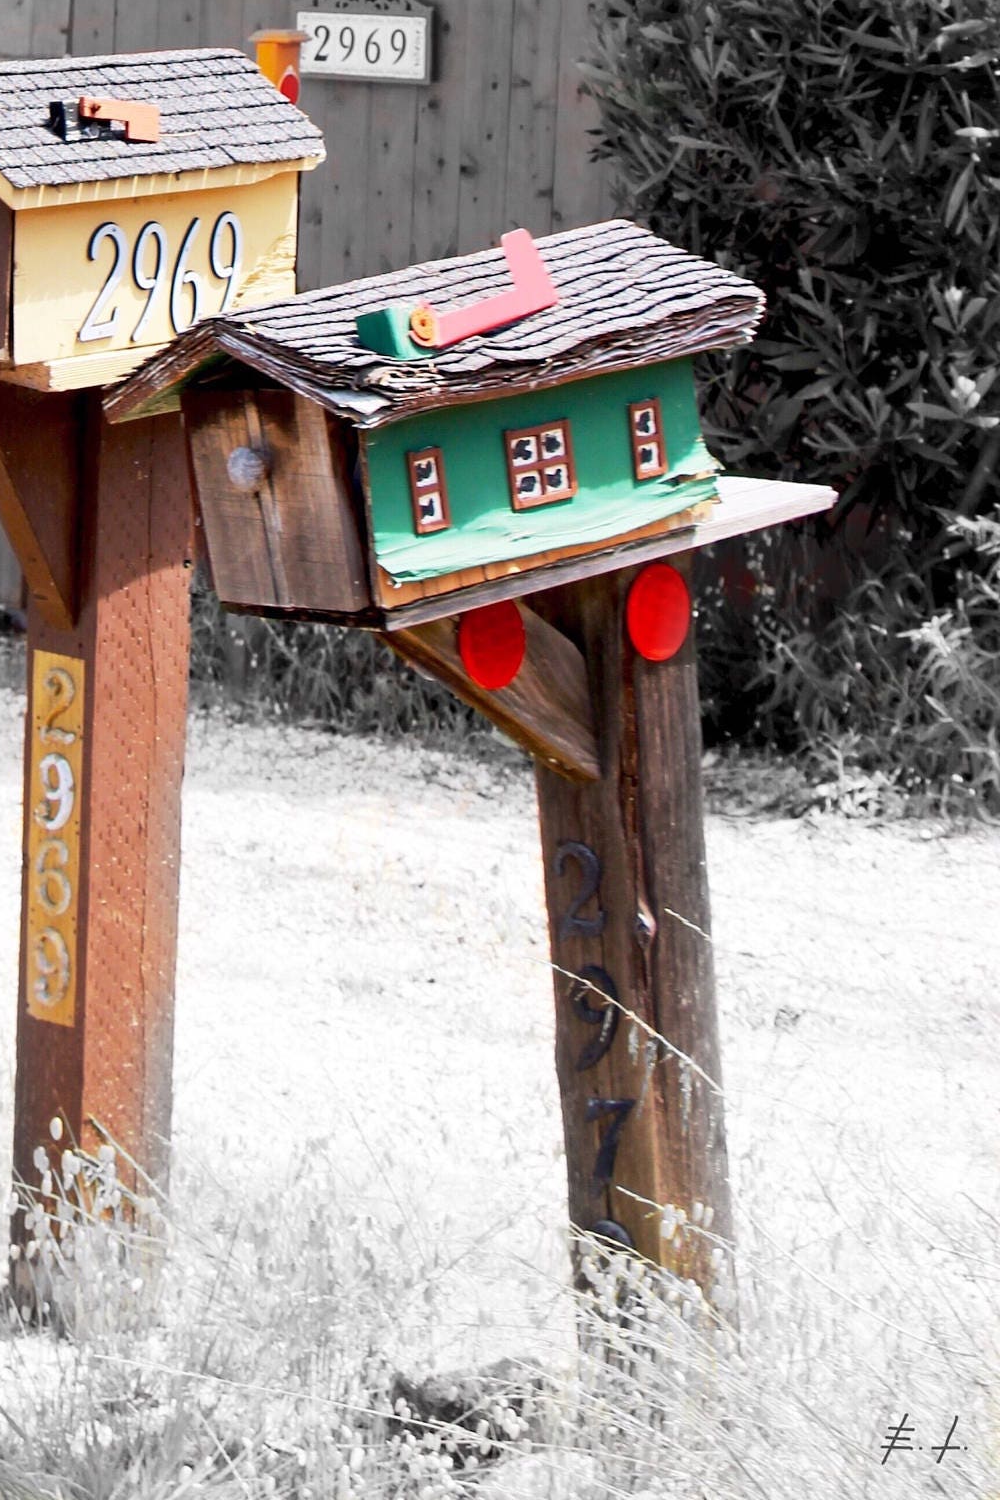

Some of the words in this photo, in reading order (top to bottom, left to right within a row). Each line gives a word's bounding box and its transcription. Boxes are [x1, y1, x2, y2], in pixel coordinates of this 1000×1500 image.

[313, 24, 408, 65] 2969
[77, 210, 244, 343] 2969
[33, 666, 77, 1007] 2969
[553, 838, 638, 1252] 297
